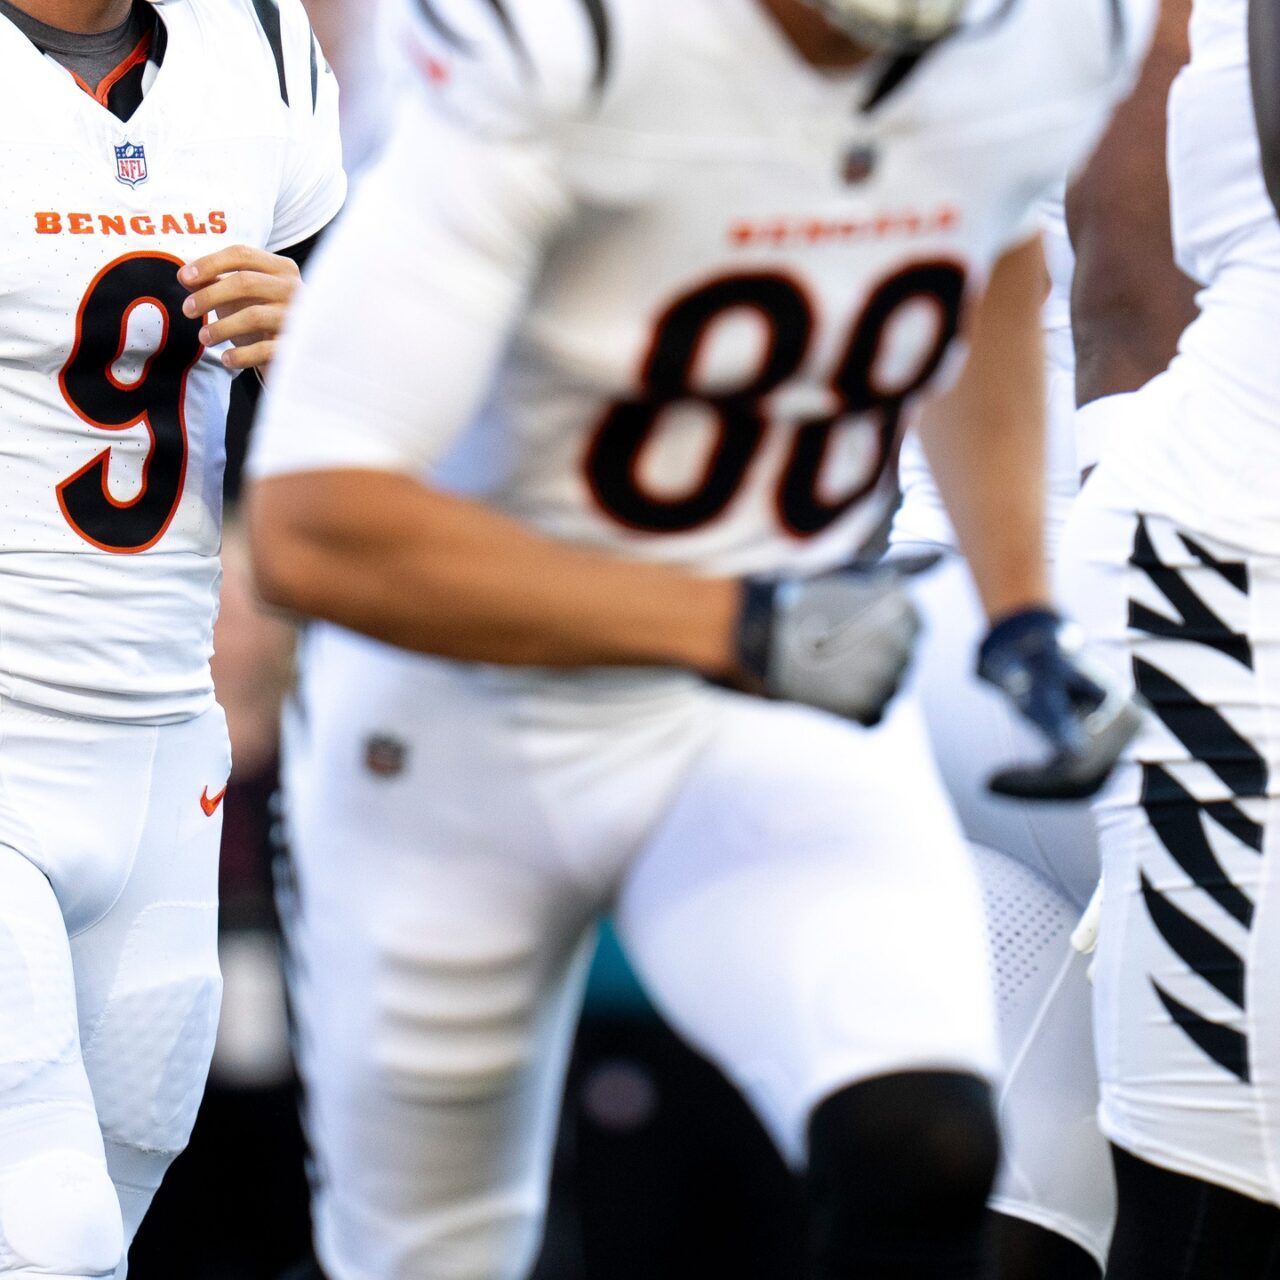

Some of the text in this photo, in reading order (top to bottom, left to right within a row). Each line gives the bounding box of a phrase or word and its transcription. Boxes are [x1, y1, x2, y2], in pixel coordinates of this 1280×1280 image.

[34, 210, 228, 236] BENGALS
[120, 160, 145, 179] NFL
[55, 250, 209, 555] 9
[582, 256, 968, 540] 88
